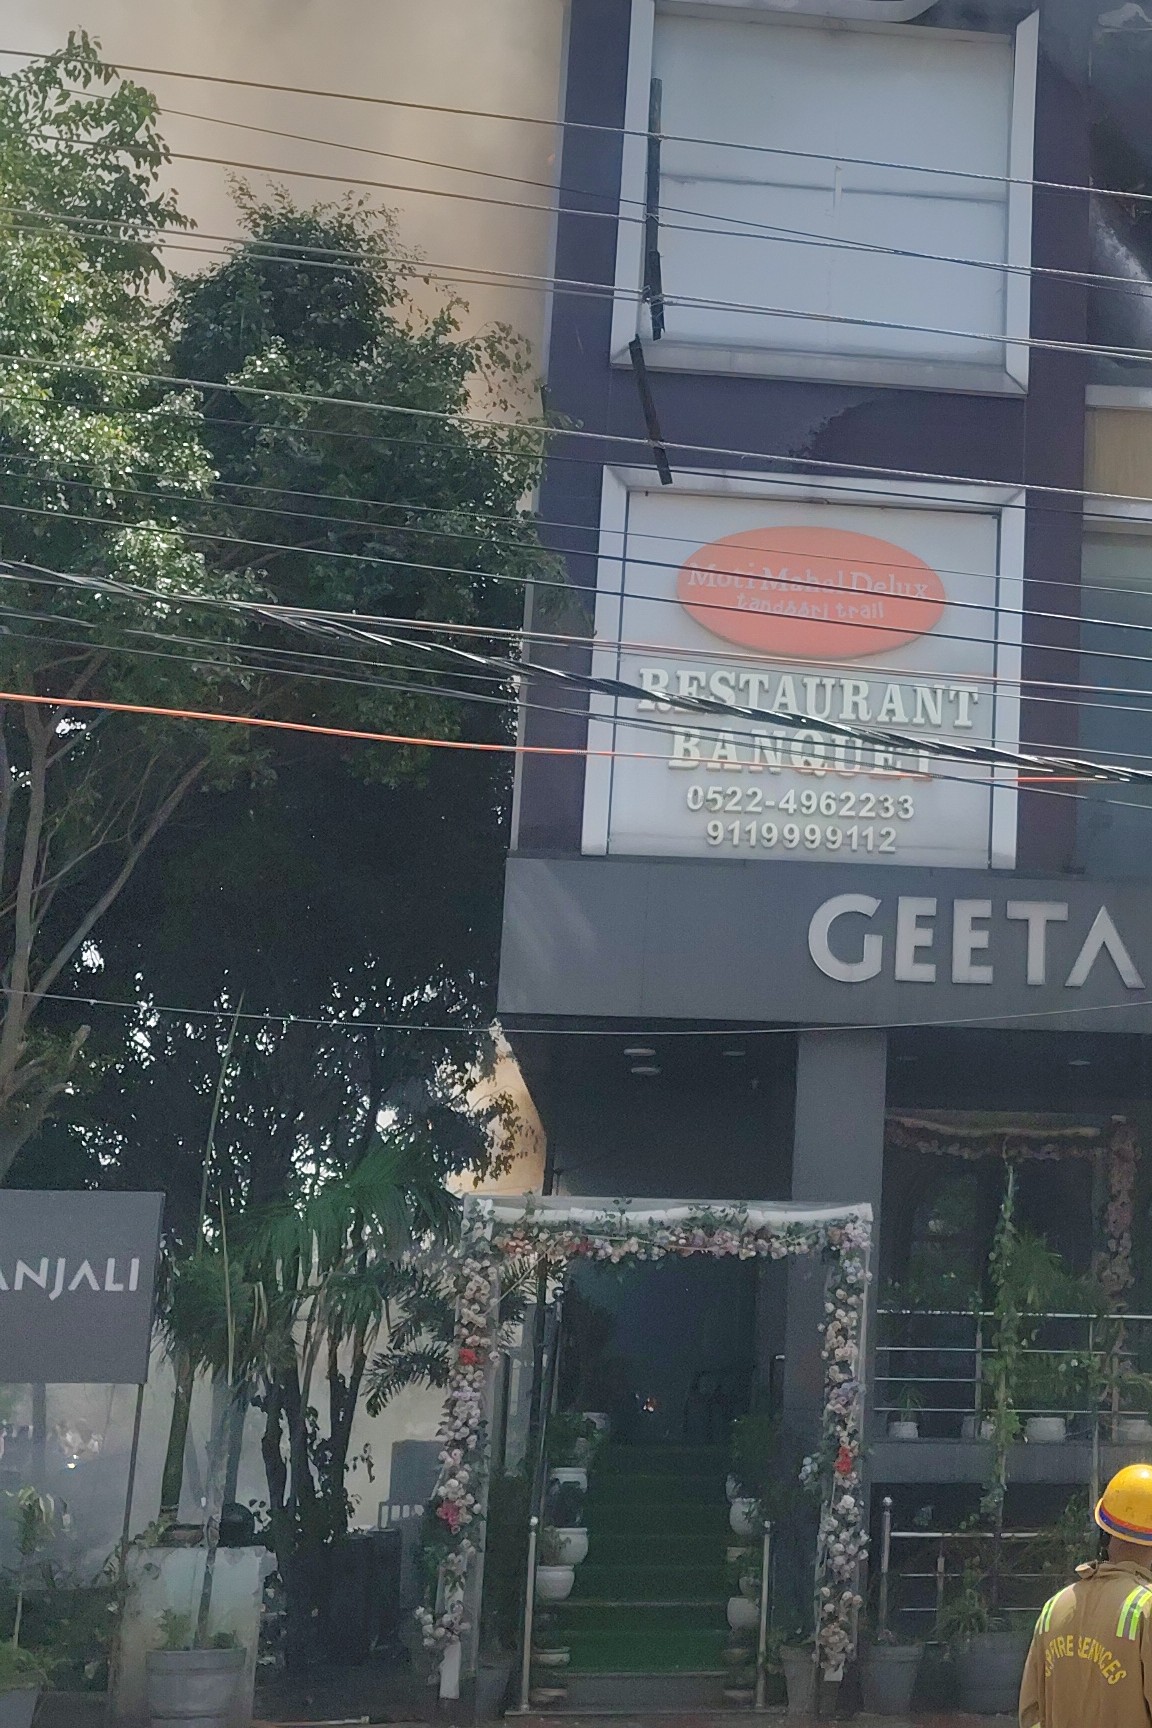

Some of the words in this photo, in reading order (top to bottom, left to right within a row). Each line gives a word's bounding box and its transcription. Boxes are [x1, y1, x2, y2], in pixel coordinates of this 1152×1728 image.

[687, 562, 755, 588] Moti
[759, 566, 845, 594] Mahal
[849, 570, 929, 598] Delux
[834, 601, 885, 620] trail
[635, 667, 979, 730] RESTAURANT
[686, 784, 915, 820] 0522-4962233
[706, 819, 897, 854] 9119999112
[0, 1257, 140, 1301] NJALI
